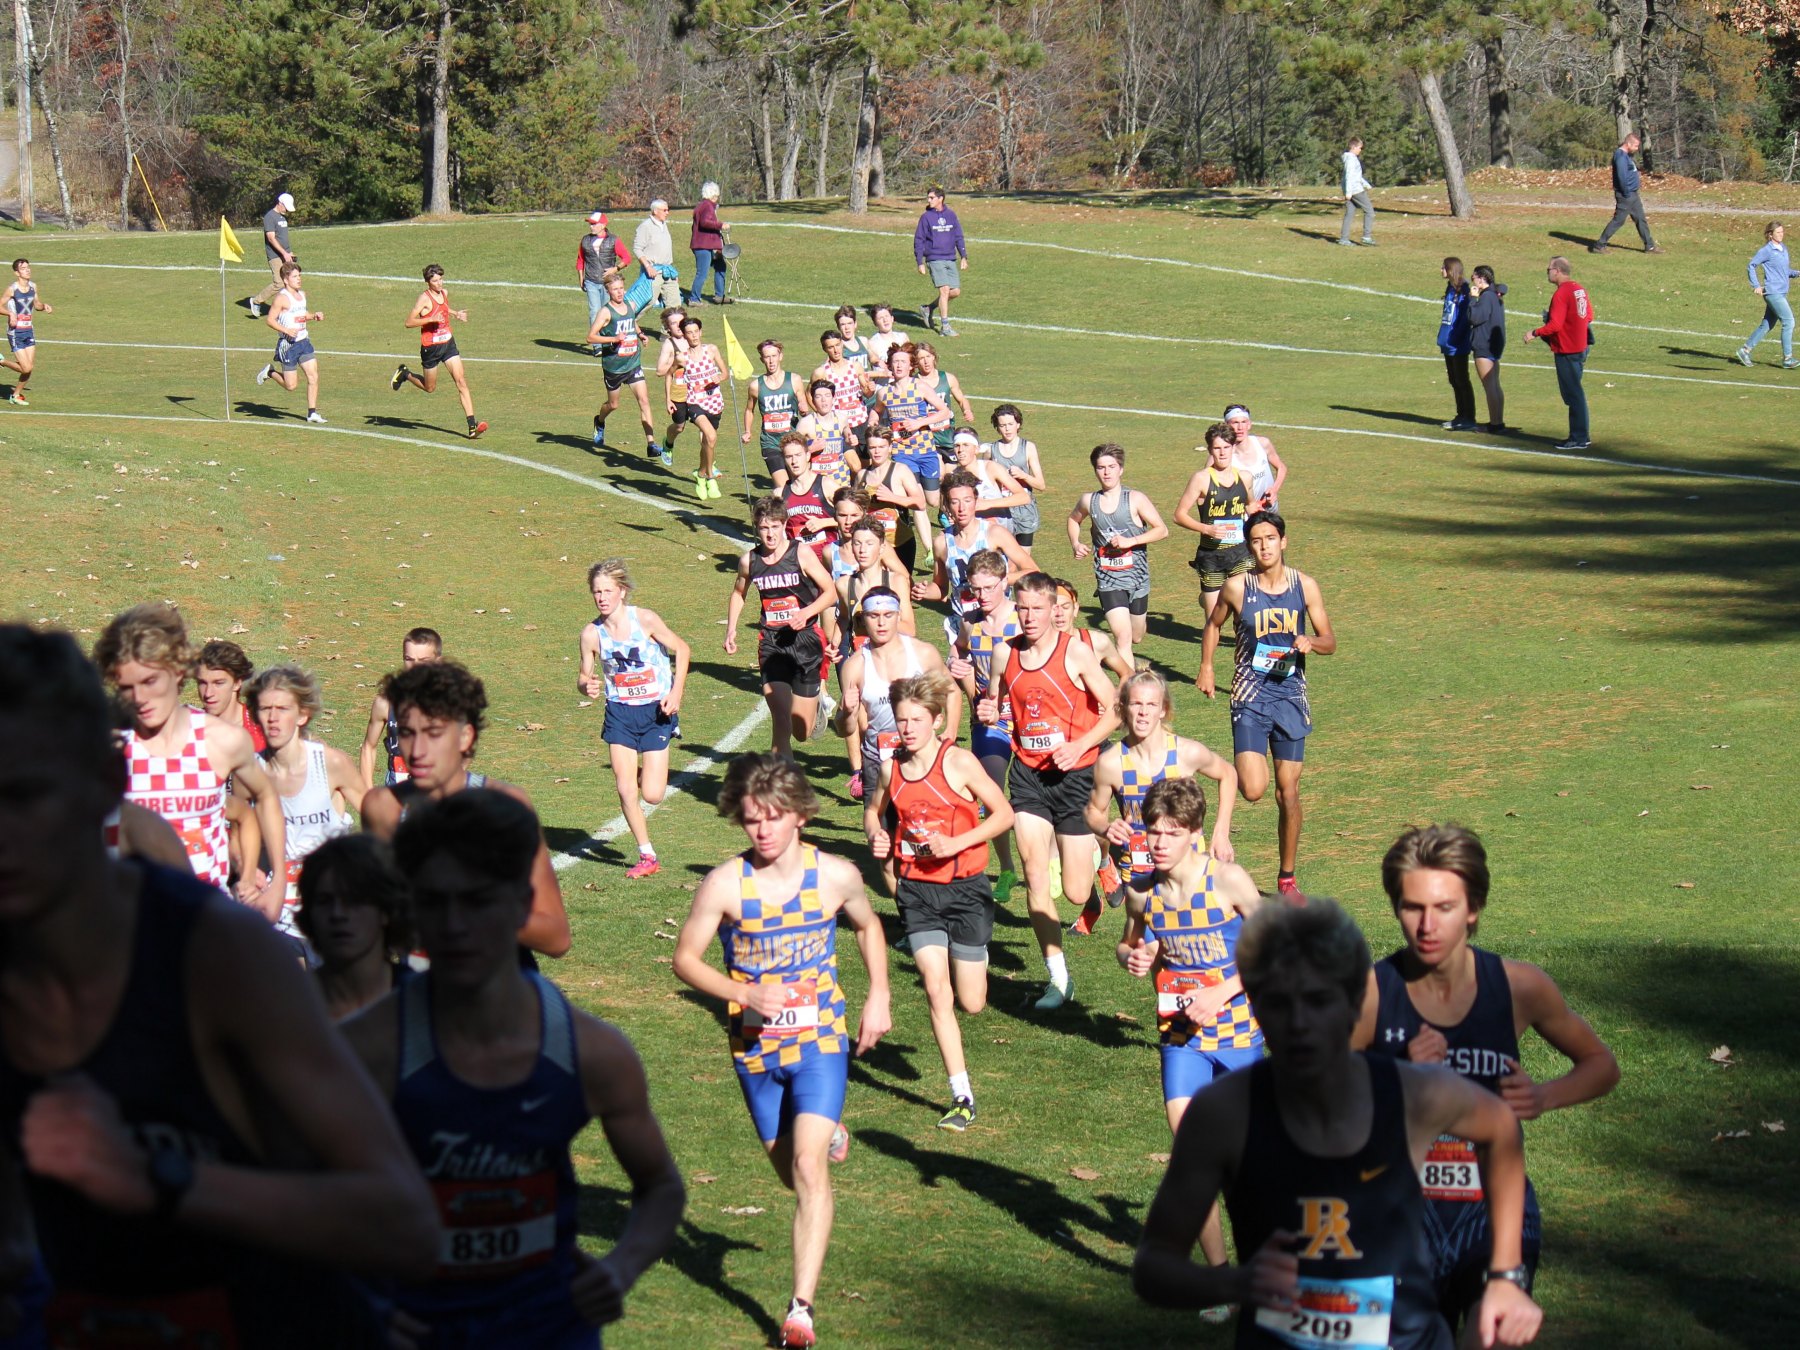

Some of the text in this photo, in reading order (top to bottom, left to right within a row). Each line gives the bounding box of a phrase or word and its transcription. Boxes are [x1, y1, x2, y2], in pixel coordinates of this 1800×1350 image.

[615, 318, 635, 335] KML
[764, 393, 792, 411] KML
[1209, 497, 1228, 517] East
[1108, 558, 1124, 566] 788
[1254, 607, 1299, 639] USM
[612, 647, 645, 672] M
[1264, 659, 1286, 671] 210
[627, 685, 647, 697] 835
[1029, 736, 1052, 749] 798
[1424, 1164, 1472, 1187] 853
[453, 1229, 520, 1262] 830
[1290, 1312, 1353, 1341] 209
